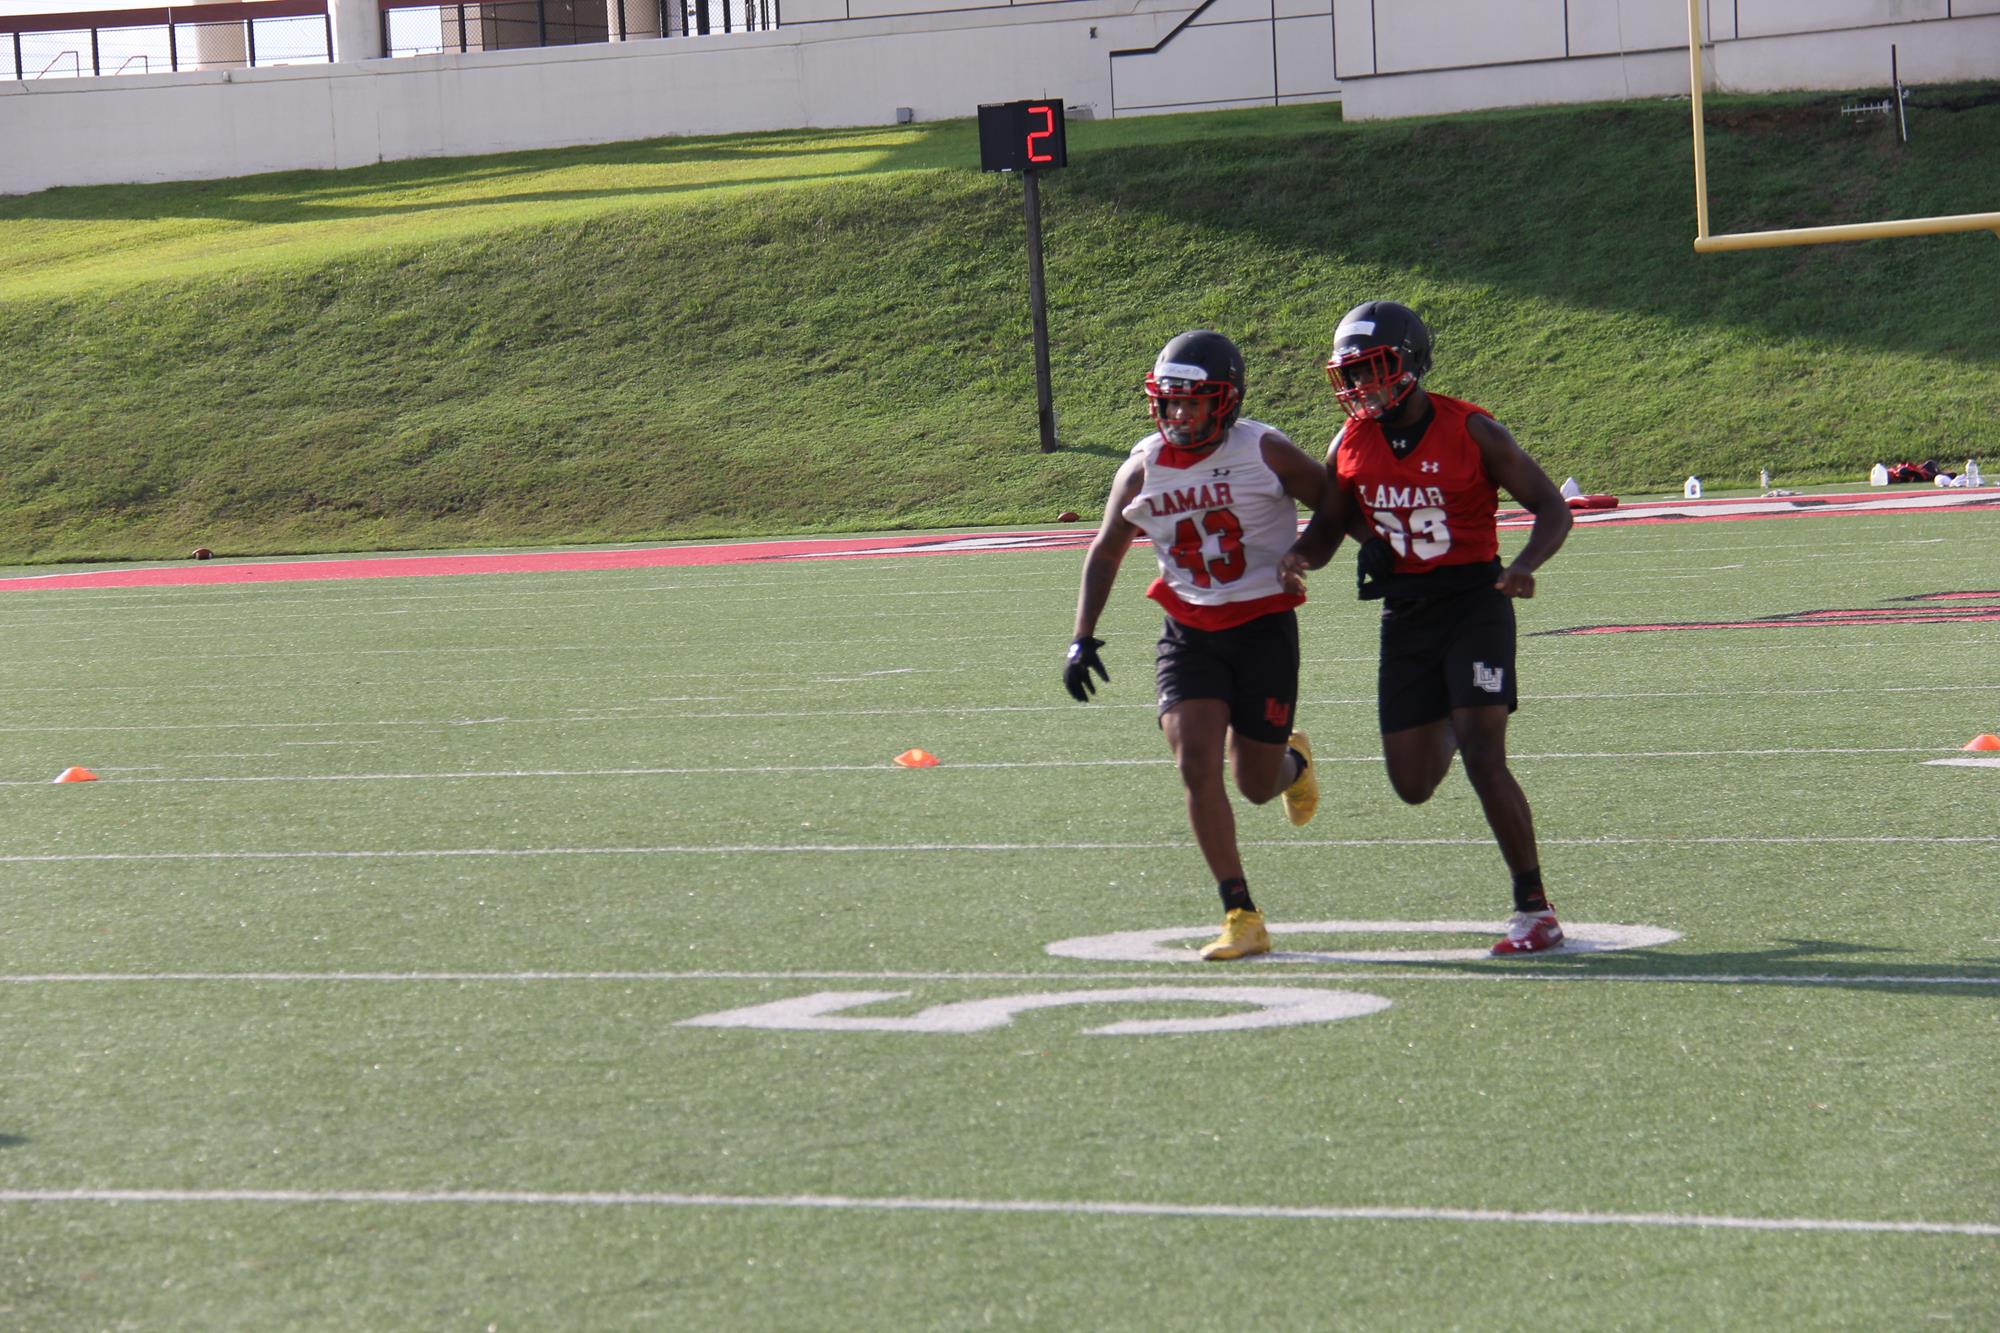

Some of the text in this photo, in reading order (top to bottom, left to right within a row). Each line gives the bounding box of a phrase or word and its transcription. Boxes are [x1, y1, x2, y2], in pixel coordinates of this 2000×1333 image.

[1027, 106, 1054, 162] 2
[1150, 482, 1233, 517] LAMAR
[1358, 484, 1446, 509] LAMAR
[1169, 507, 1247, 589] 43
[1472, 662, 1503, 692] LU
